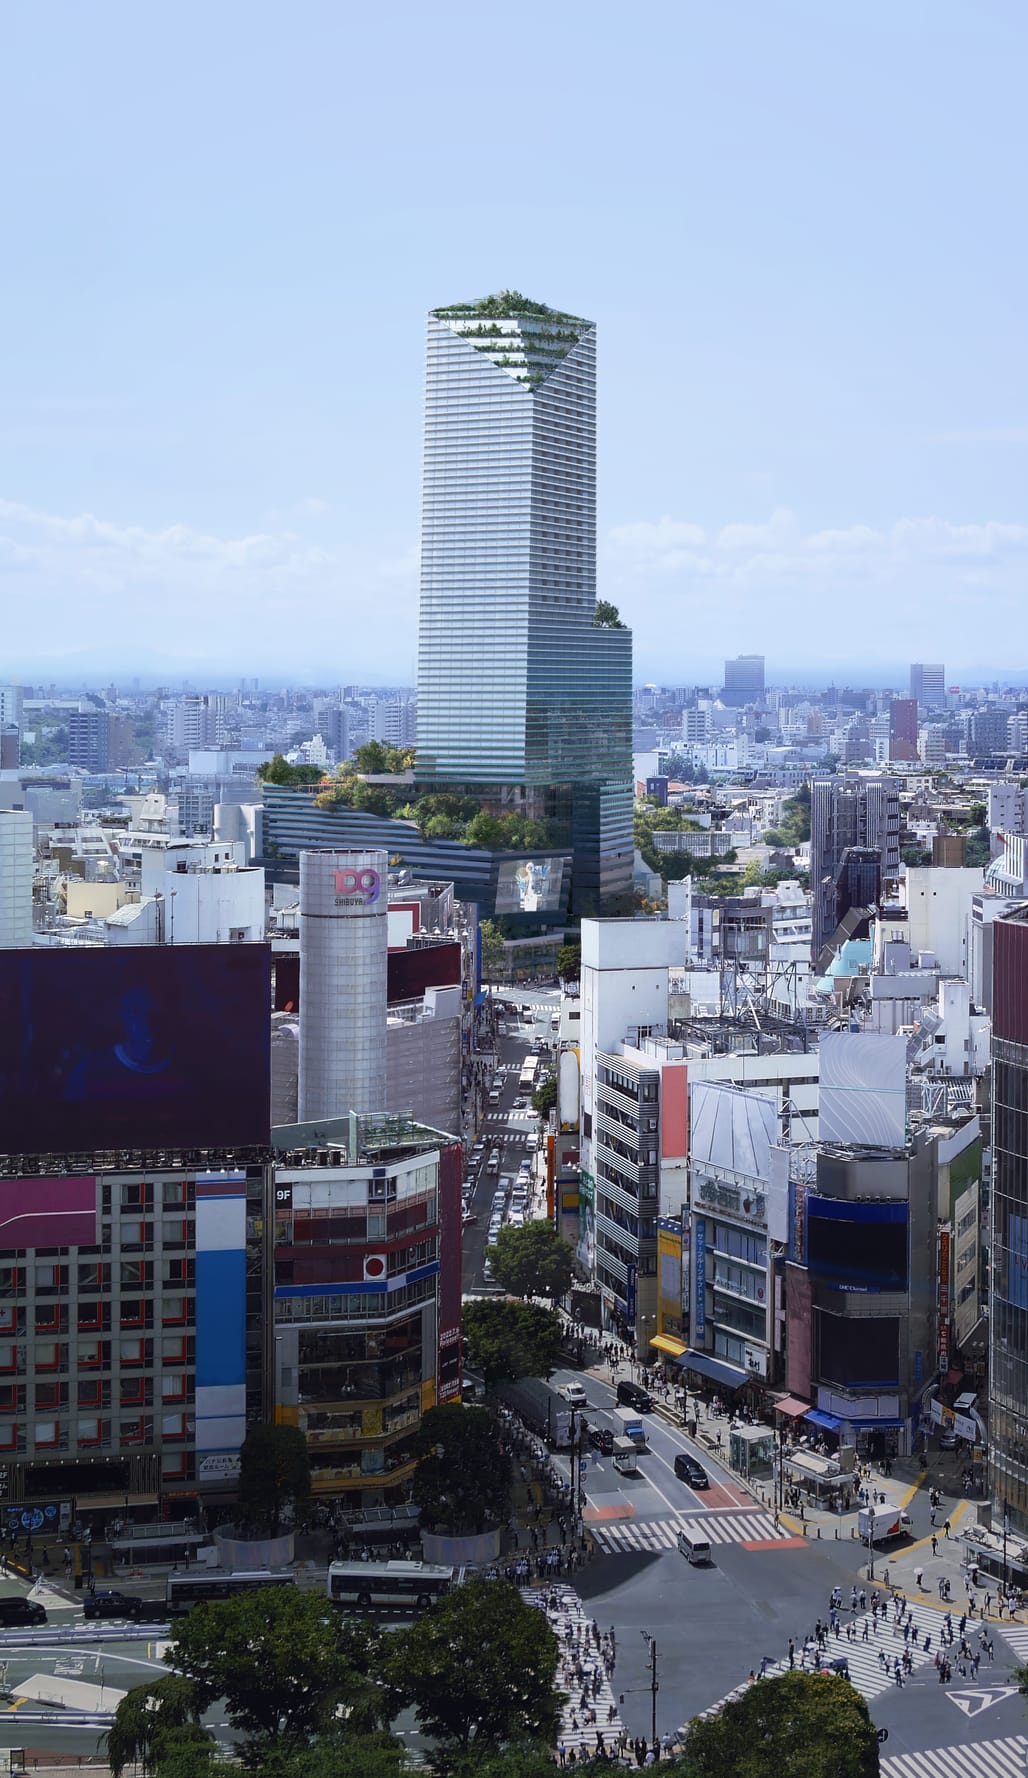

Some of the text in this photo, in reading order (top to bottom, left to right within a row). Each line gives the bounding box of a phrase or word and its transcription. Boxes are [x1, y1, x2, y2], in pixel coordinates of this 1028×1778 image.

[332, 868, 380, 905] 109
[334, 898, 364, 907] SHIBUYA
[276, 1190, 291, 1201] 9F
